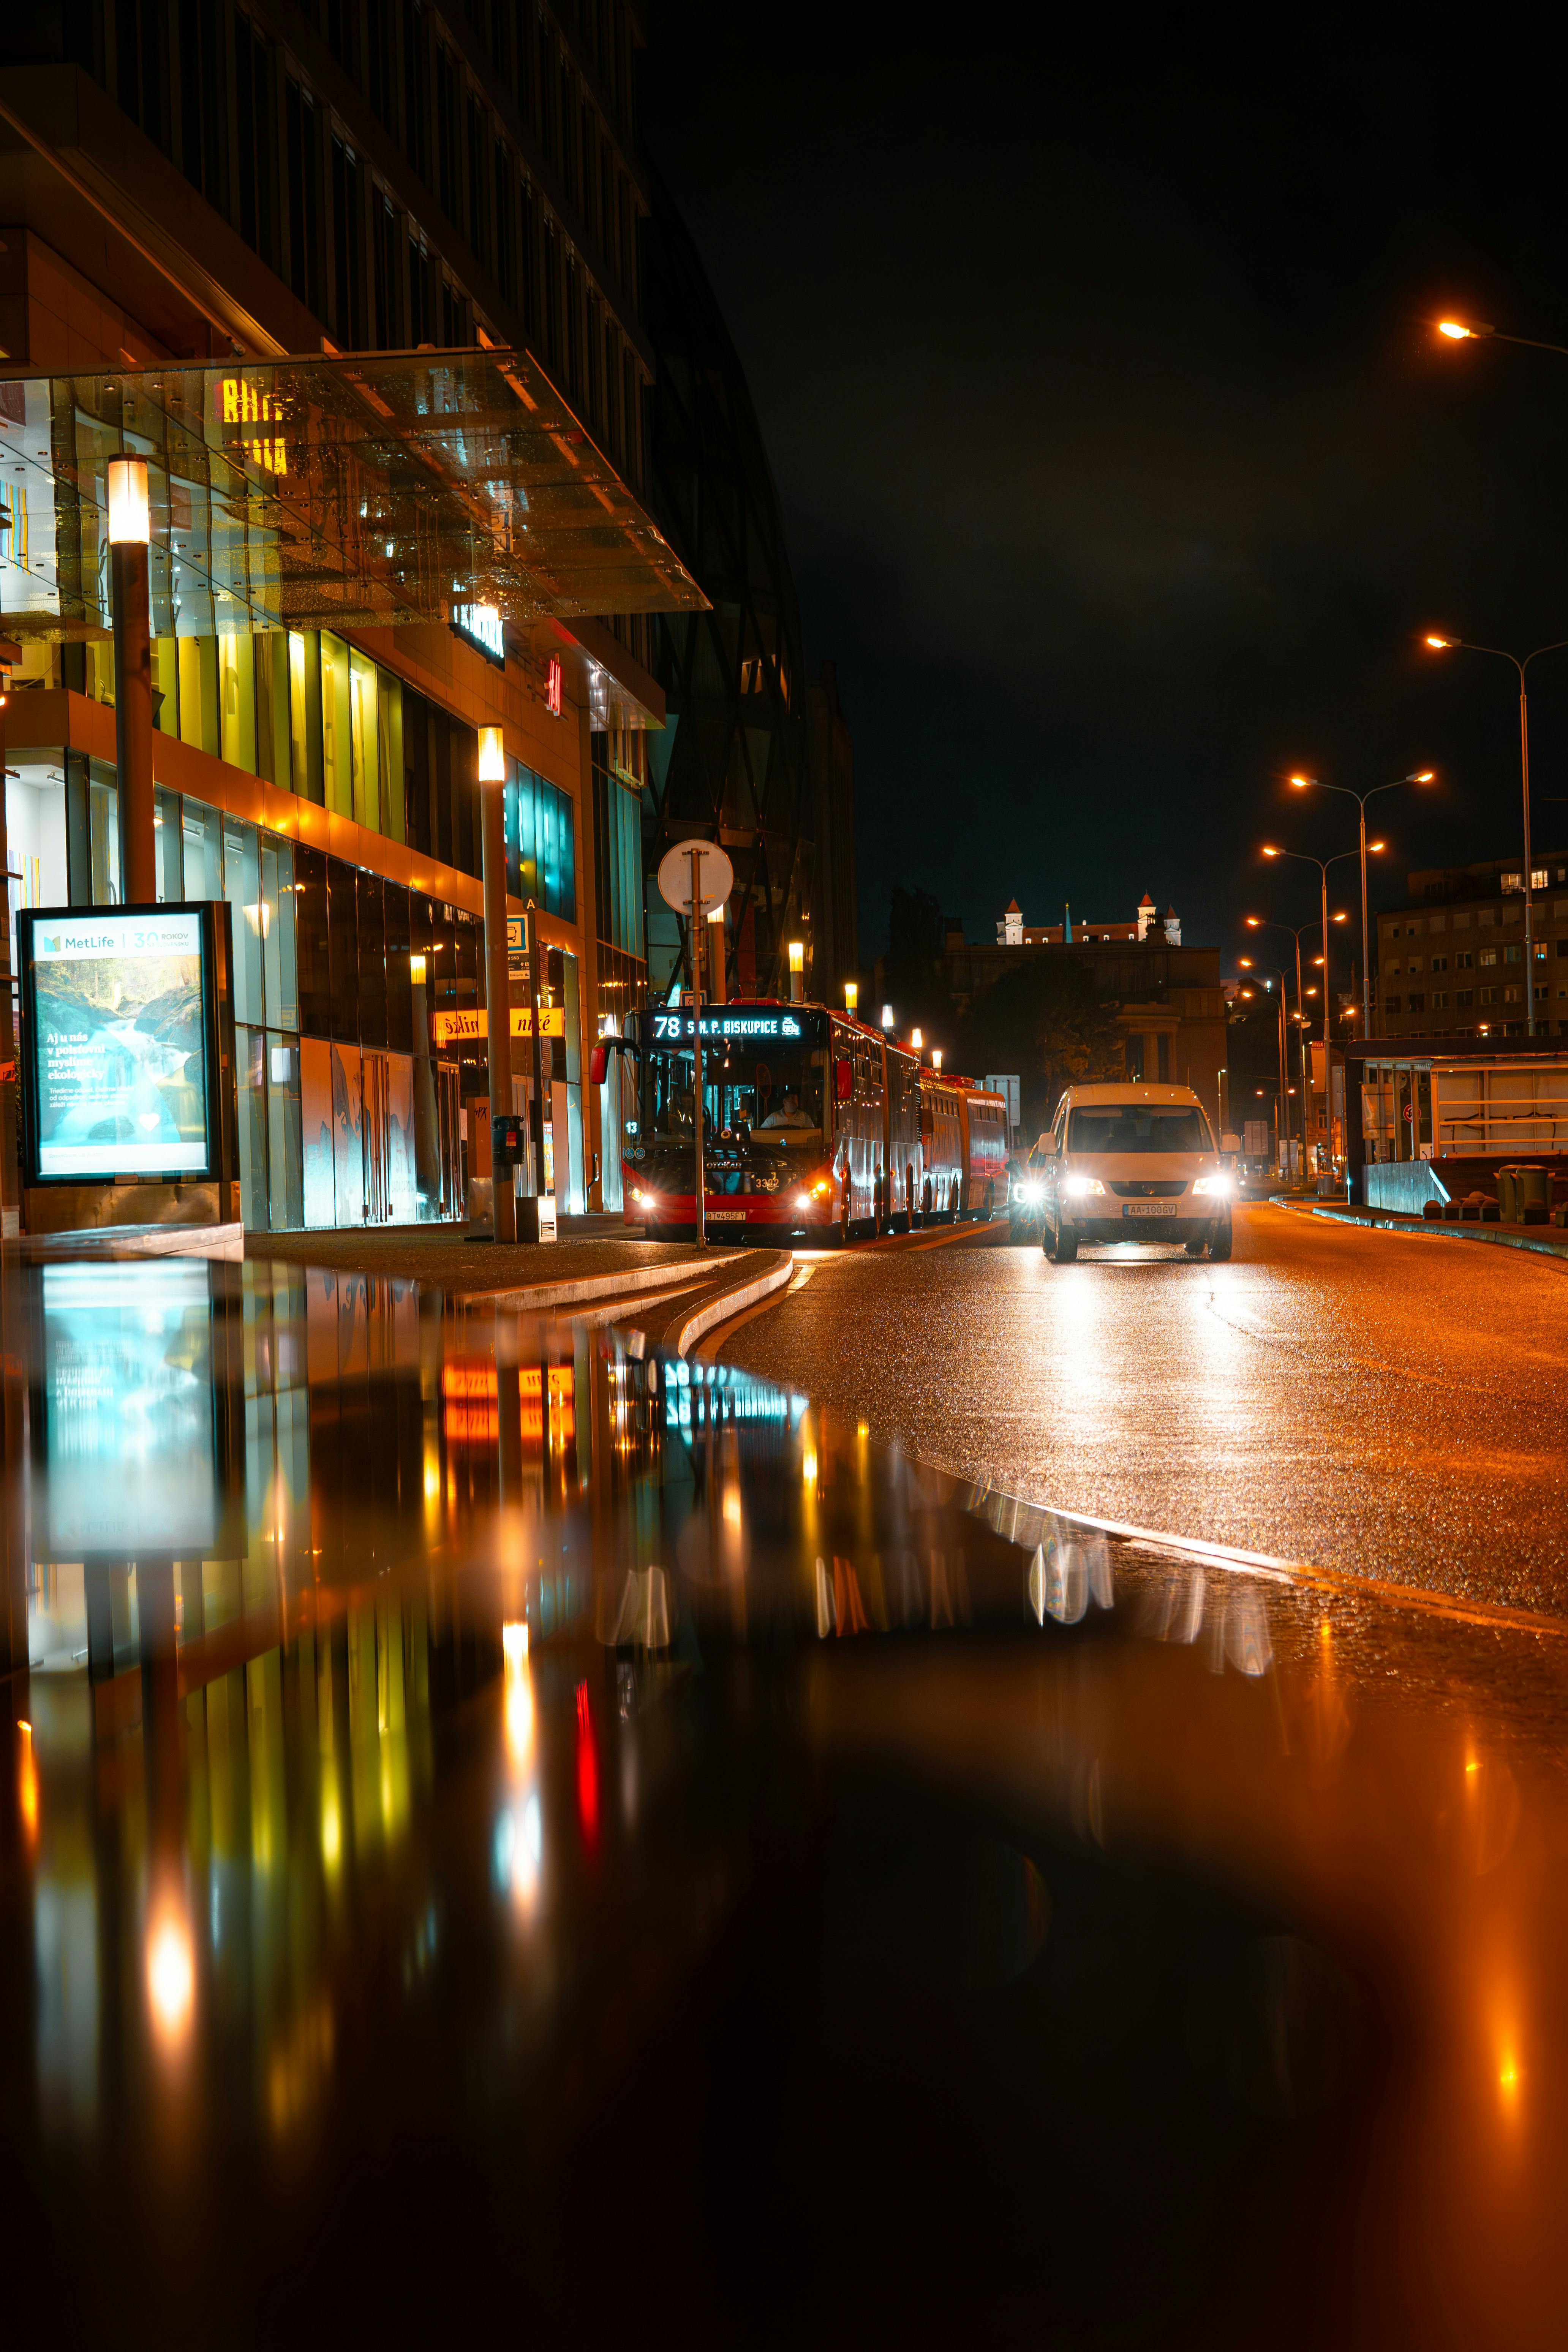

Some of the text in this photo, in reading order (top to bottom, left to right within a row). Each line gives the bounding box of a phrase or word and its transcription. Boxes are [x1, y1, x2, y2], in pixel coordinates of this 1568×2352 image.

[526, 899, 535, 909] A
[65, 936, 114, 948] MetLife
[655, 1017, 680, 1037] 78
[711, 1021, 721, 1034] P.
[724, 1020, 778, 1034] BISKUPICE
[46, 1033, 58, 1045] Aj
[69, 1032, 88, 1042] nás
[55, 1043, 105, 1057] poisťovni
[48, 1057, 93, 1069] myslíme
[48, 1069, 104, 1081] ekologicky
[626, 1121, 637, 1133] 13
[756, 1178, 779, 1188] 3322
